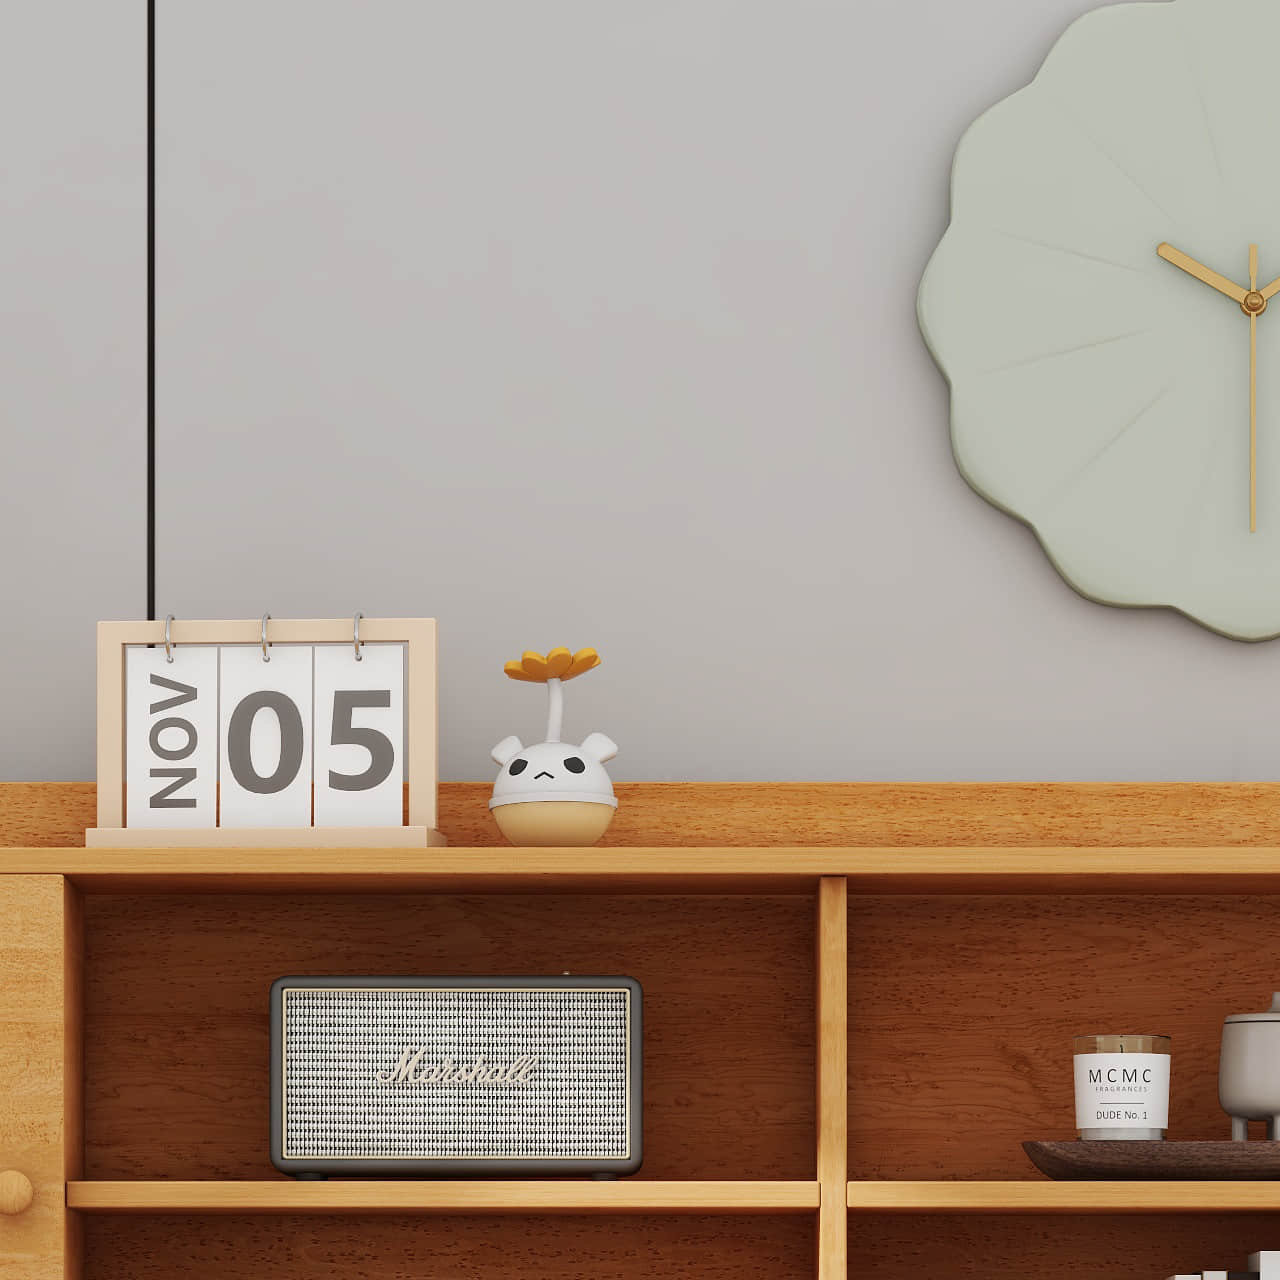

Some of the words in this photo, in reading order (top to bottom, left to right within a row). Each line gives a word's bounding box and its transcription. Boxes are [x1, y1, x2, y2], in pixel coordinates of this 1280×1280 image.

[149, 673, 198, 808] NOV
[227, 690, 395, 794] 05
[376, 1046, 538, 1084] Marshall
[1089, 1068, 1152, 1083] MCMC
[1096, 1111, 1121, 1120] DUDE
[1124, 1111, 1140, 1120] No.
[1142, 1111, 1148, 1120] 1
